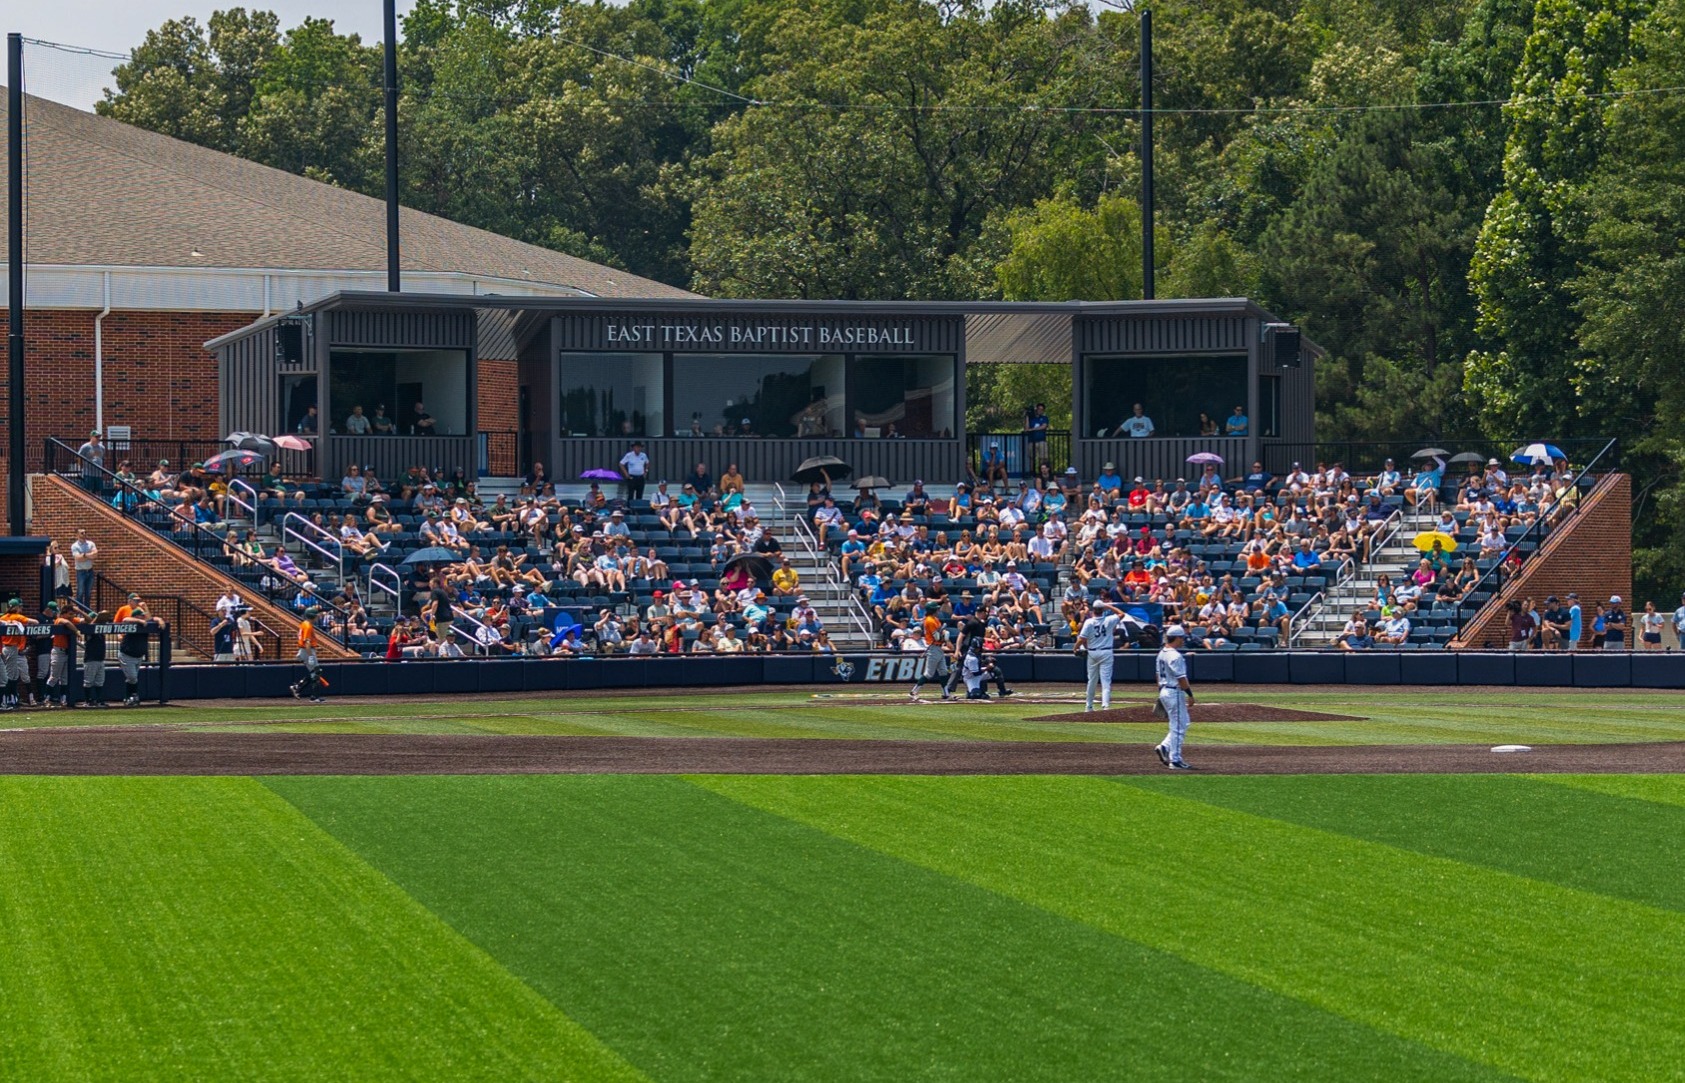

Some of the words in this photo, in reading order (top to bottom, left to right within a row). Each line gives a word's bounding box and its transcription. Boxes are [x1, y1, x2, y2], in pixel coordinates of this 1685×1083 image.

[607, 325, 655, 341] EAST
[661, 325, 722, 342] TEXAS
[731, 326, 812, 343] BAPTIST
[819, 327, 914, 344] BASEBALL
[6, 626, 24, 635] ET
[26, 625, 51, 635] TIGERS
[94, 625, 112, 634] ETBU
[113, 624, 137, 633] TIGERS
[1094, 625, 1107, 638] 34
